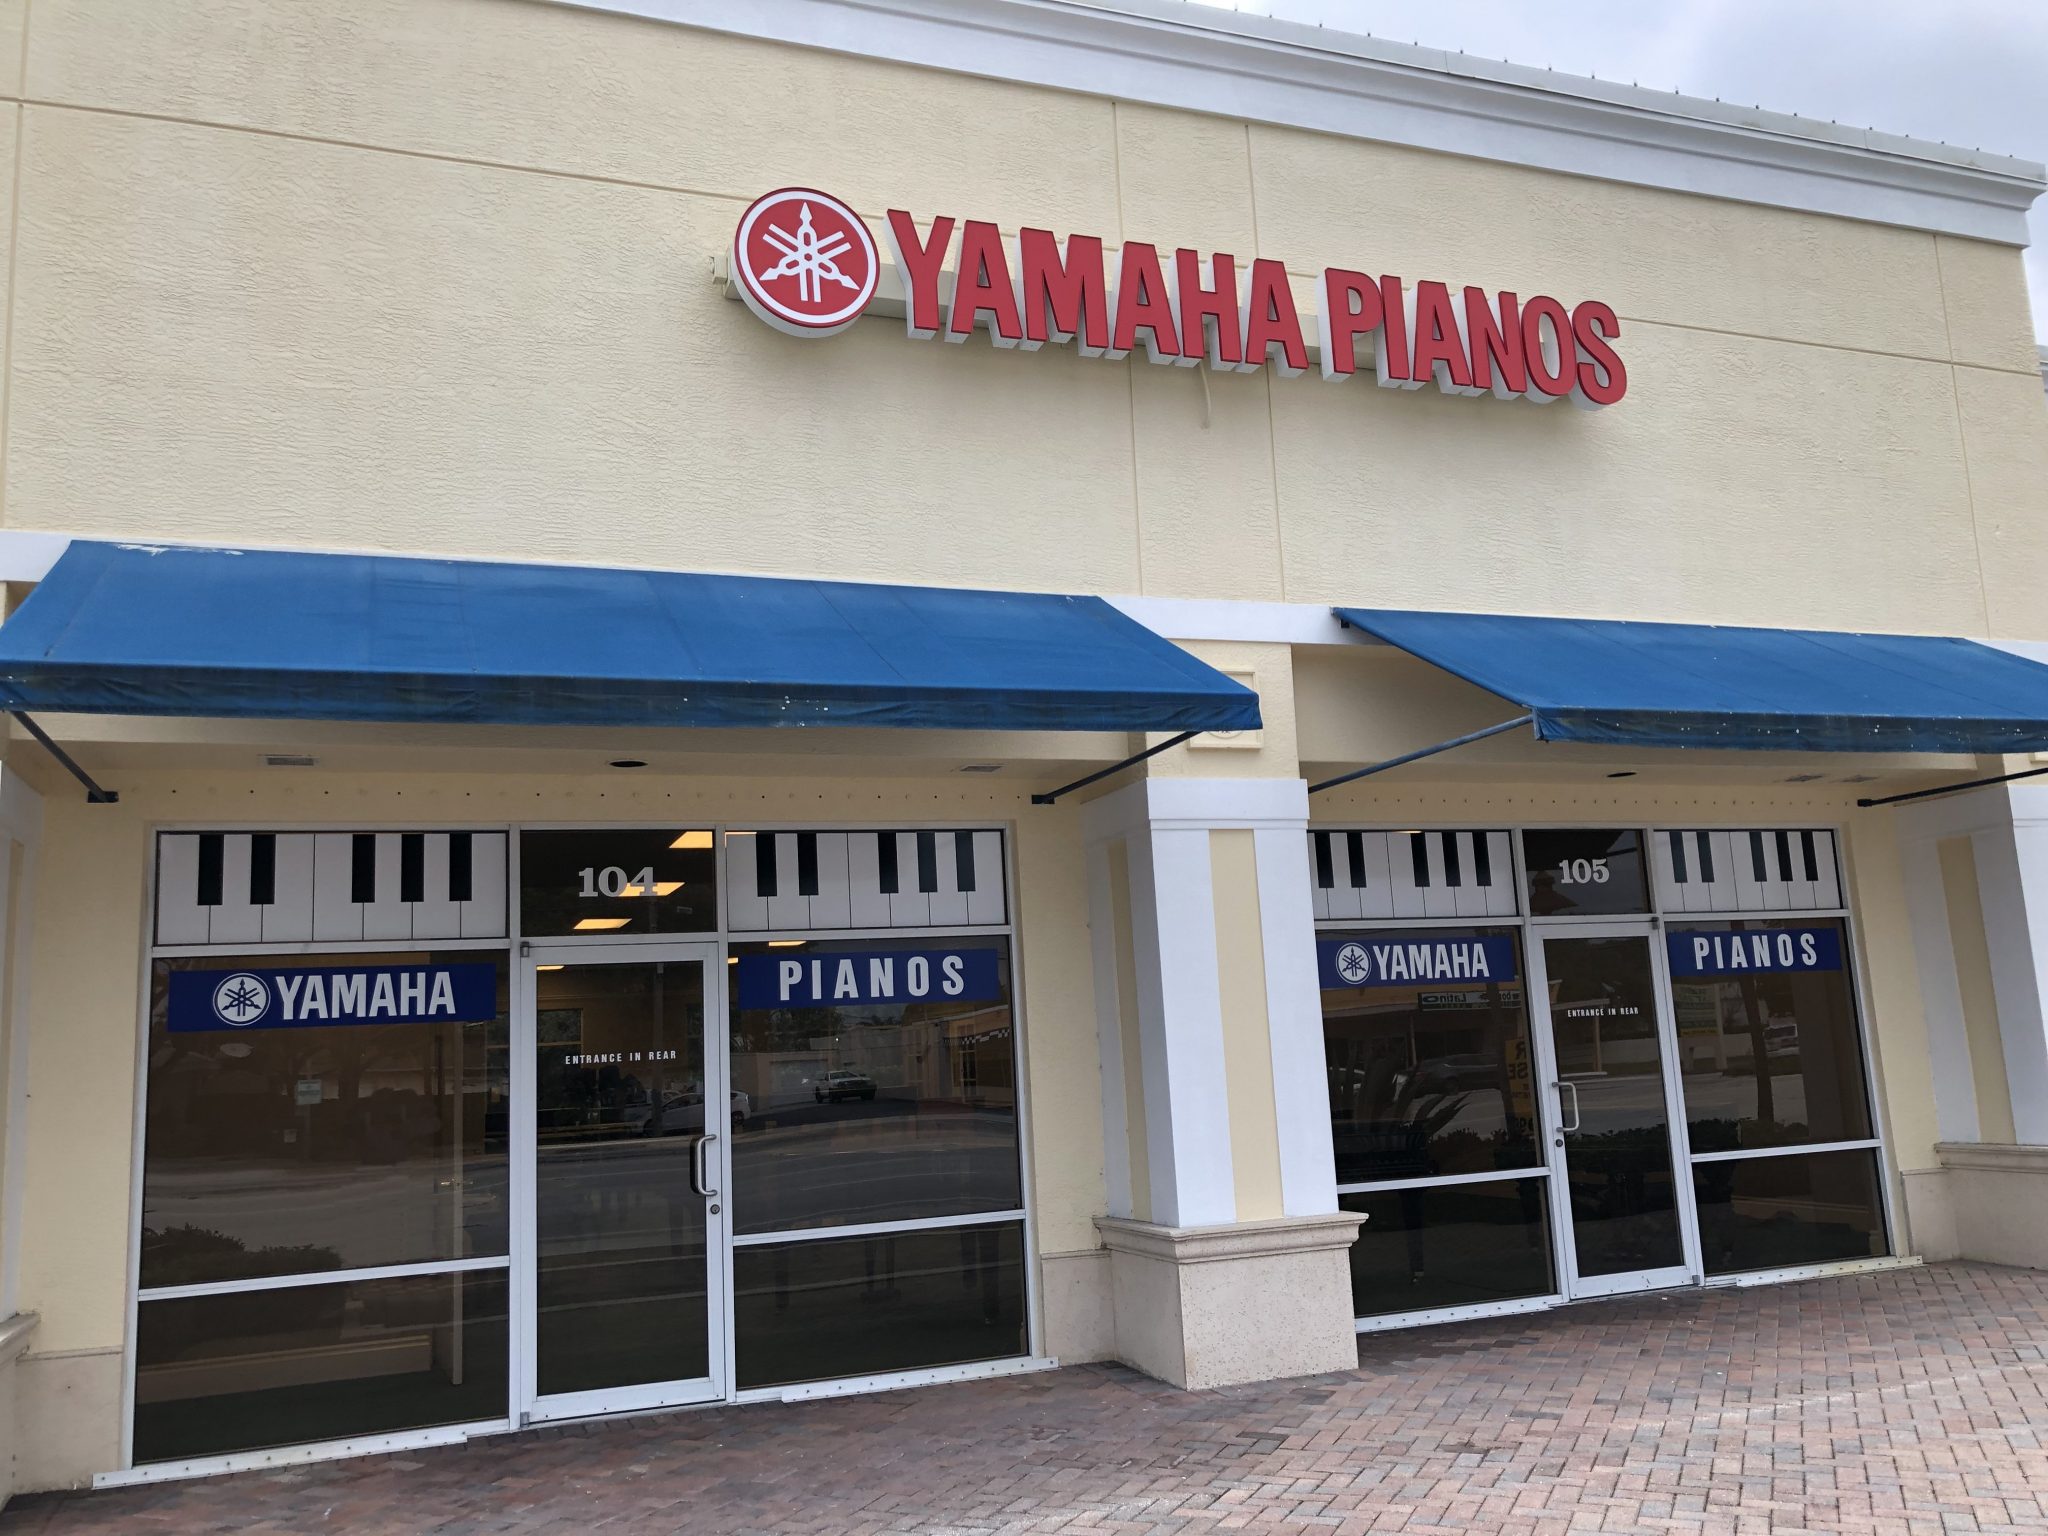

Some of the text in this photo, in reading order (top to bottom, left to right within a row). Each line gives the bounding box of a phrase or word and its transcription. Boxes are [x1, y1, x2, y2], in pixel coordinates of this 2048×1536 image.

[887, 209, 1628, 406] YAMAHA PIANOS
[578, 866, 658, 898] 104
[1559, 858, 1610, 884] 105
[1372, 943, 1490, 980] YAMAHA
[1693, 933, 1818, 970] PIANOS
[275, 971, 456, 1020] YAMAHA
[779, 955, 964, 1001] PIANOS
[1567, 1006, 1639, 1018] ENTRANCE IN REAR
[565, 1050, 677, 1065] ENTRANCE IN REAR
